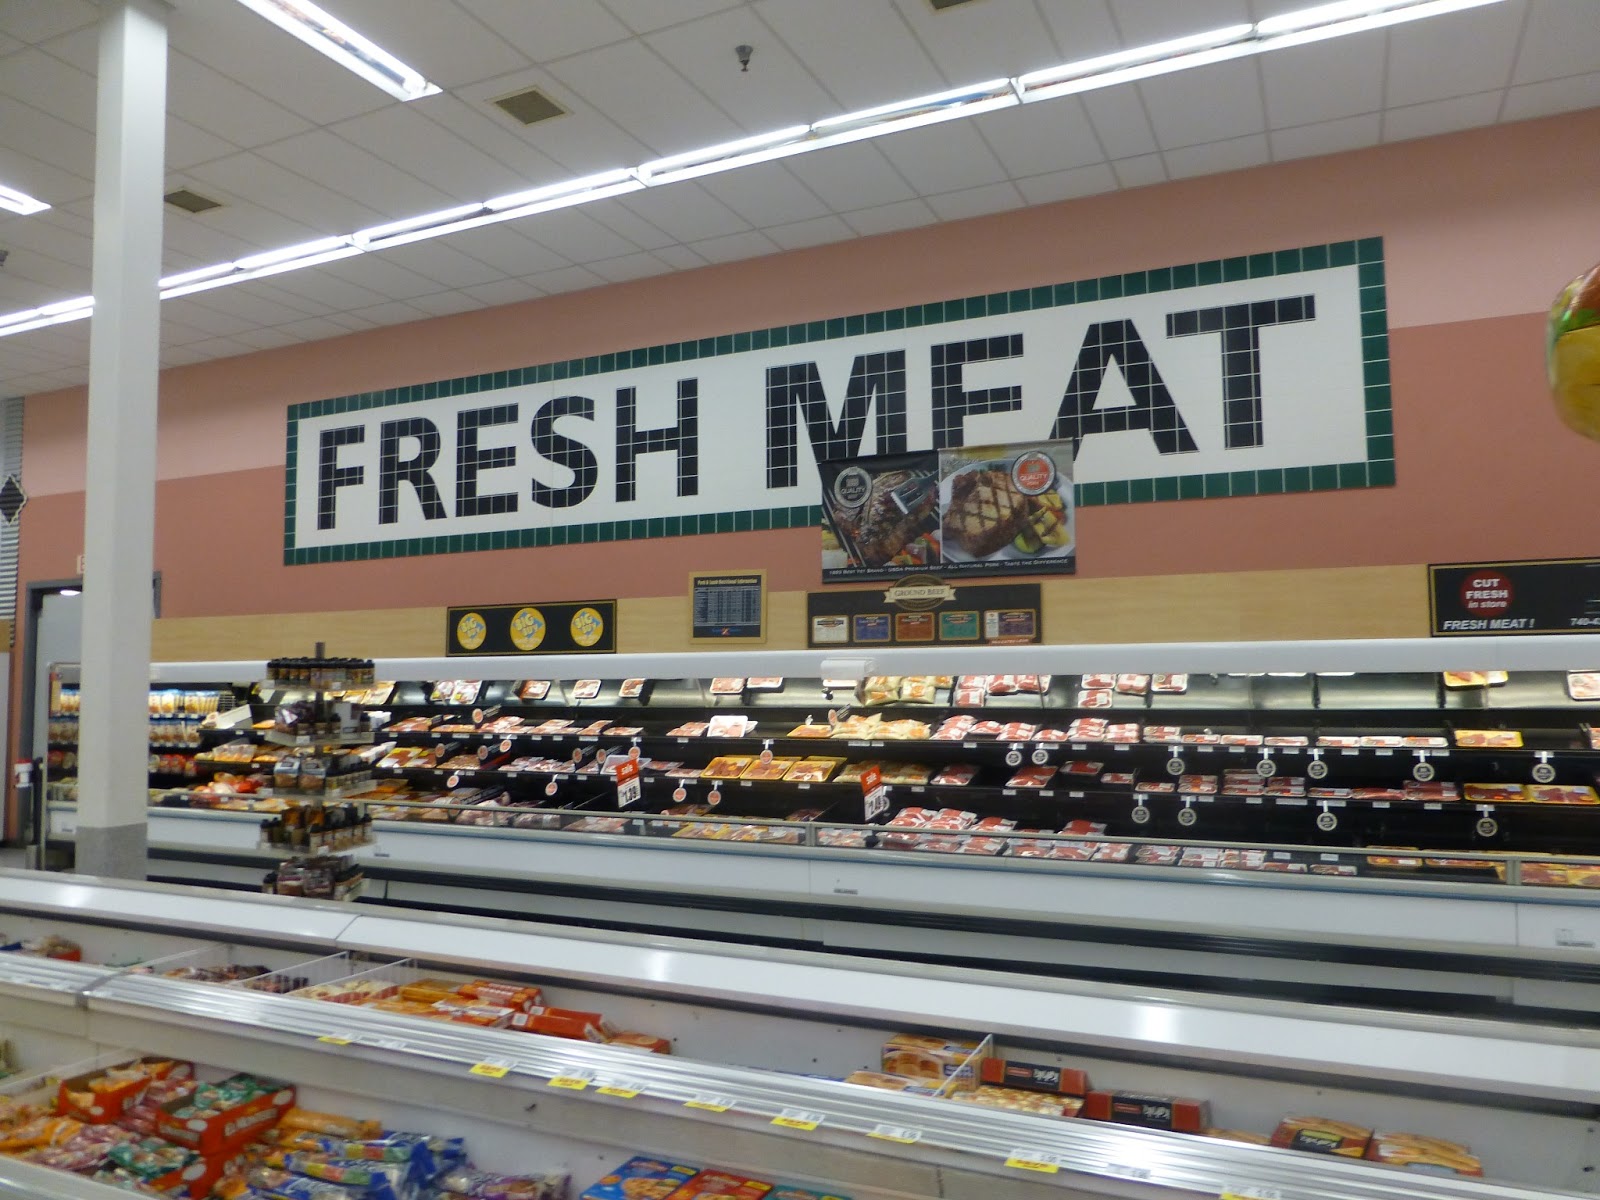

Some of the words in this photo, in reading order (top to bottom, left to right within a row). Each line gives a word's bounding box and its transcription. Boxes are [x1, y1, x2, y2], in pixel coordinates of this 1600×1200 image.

[318, 377, 698, 530] FRESH
[766, 294, 1316, 490] MEAT
[1472, 578, 1500, 587] CUT
[895, 589, 926, 597] GROUND
[927, 588, 945, 596] BEEF
[1465, 590, 1508, 599] FRESH
[1468, 600, 1479, 608] in
[1480, 600, 1507, 608] store
[1443, 619, 1488, 630] FRESH
[1489, 618, 1528, 629] MEAT
